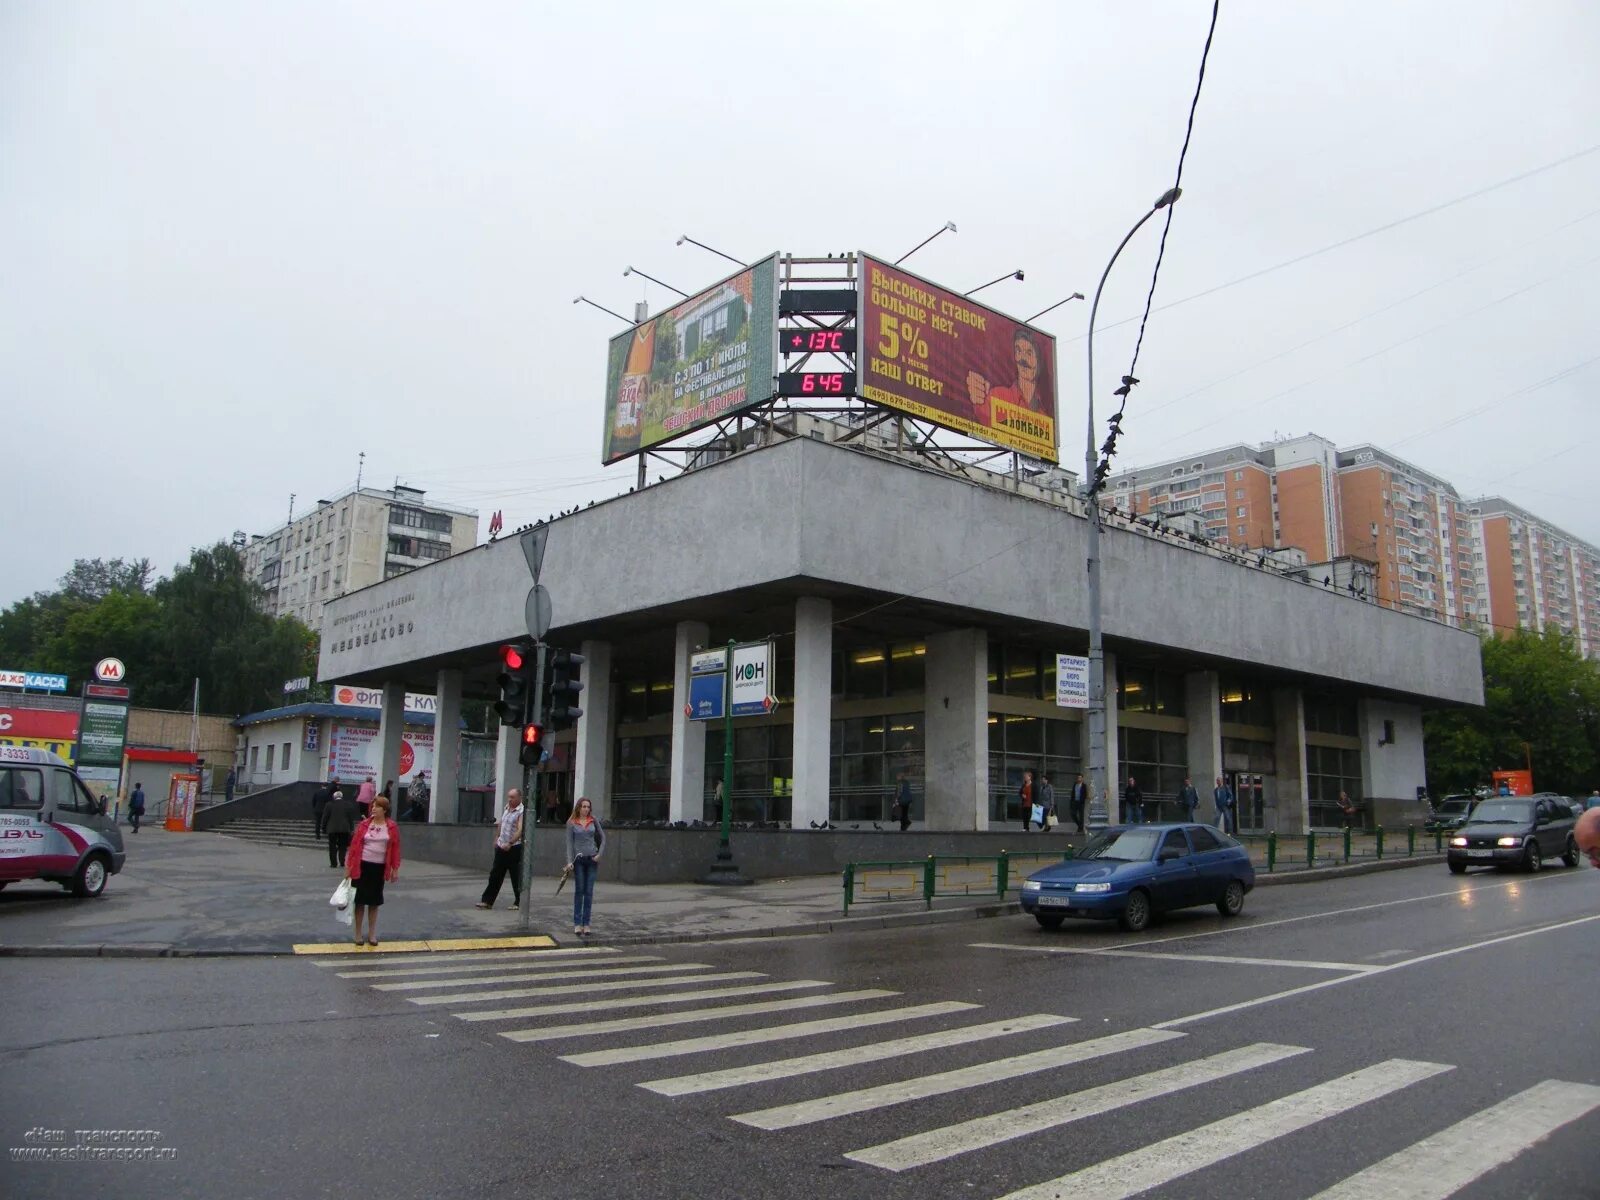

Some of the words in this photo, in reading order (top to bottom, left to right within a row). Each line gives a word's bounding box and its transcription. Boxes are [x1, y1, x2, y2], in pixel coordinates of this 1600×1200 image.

[871, 267, 937, 310] Высоких
[941, 300, 986, 332] ставок
[871, 287, 927, 324] больше
[931, 313, 959, 338] нет,
[878, 312, 929, 359] 5%
[674, 386, 683, 399] НА
[685, 367, 726, 393] ФЕСТИВАЛЕ
[727, 358, 747, 376] ПИВА
[675, 371, 681, 385] С
[683, 368, 689, 381] 3
[690, 361, 703, 378] ПО
[705, 356, 715, 371] 11
[718, 341, 747, 366] ИЮЛЯ
[870, 357, 902, 382] наш
[905, 370, 944, 396] ответ
[700, 390, 705, 401] В
[706, 372, 746, 398] ЛУЖНИКАХ
[706, 386, 746, 419] ДВОРИК
[1008, 417, 1050, 441] ЛОМБАРД
[331, 620, 414, 655] МЕДВЕДКОВО
[735, 661, 764, 681] ИОН
[1059, 658, 1086, 667] НОТАРИУС
[25, 674, 66, 688] КАССА
[345, 728, 379, 737] НАЧНИ
